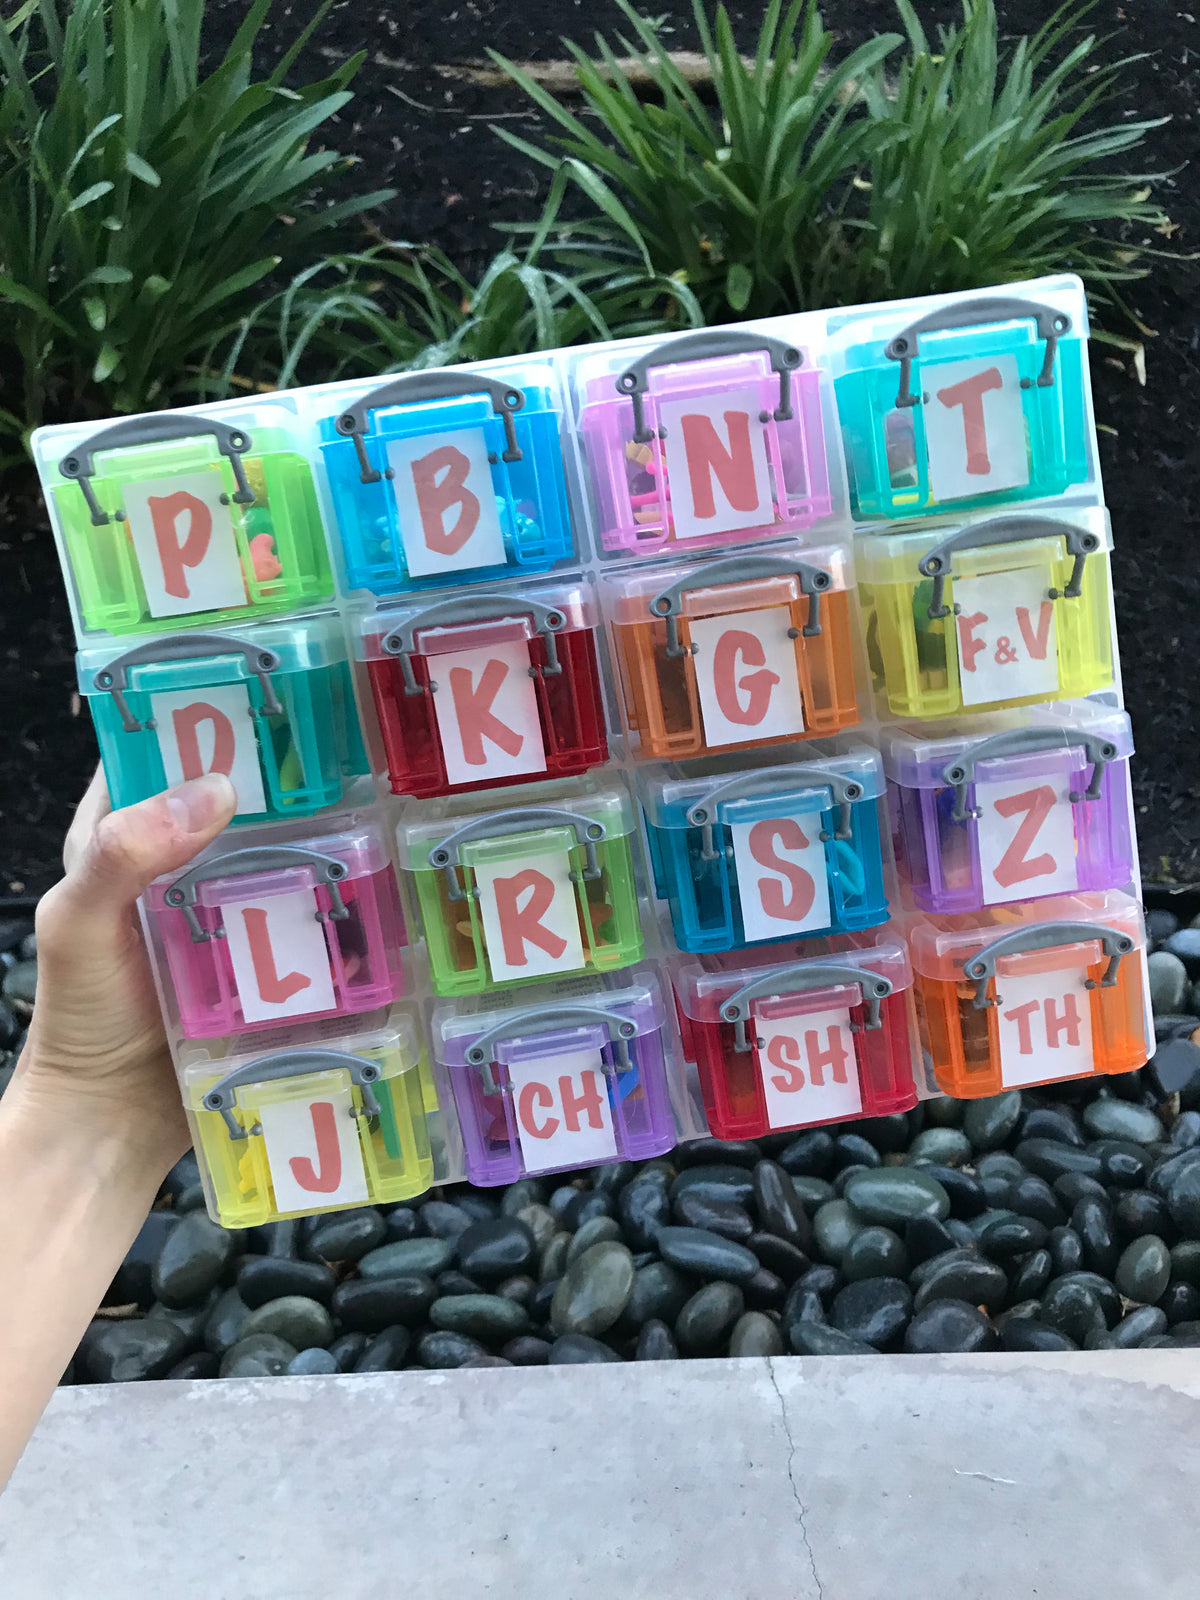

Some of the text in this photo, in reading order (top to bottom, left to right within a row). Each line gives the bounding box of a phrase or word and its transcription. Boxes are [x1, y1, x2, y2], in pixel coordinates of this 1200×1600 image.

[680, 410, 760, 519] N
[937, 367, 1002, 475] T
[148, 490, 212, 599] P
[411, 445, 480, 556] B
[449, 658, 524, 766] K
[713, 629, 781, 726] G
[172, 702, 235, 784] D
[748, 818, 816, 922] S
[993, 785, 1058, 888] Z
[242, 907, 312, 1004] L
[494, 869, 568, 966] R
[767, 1025, 849, 1093] SH
[1004, 993, 1082, 1055] TH
[289, 1102, 342, 1194] J
[518, 1069, 604, 1140] CH
